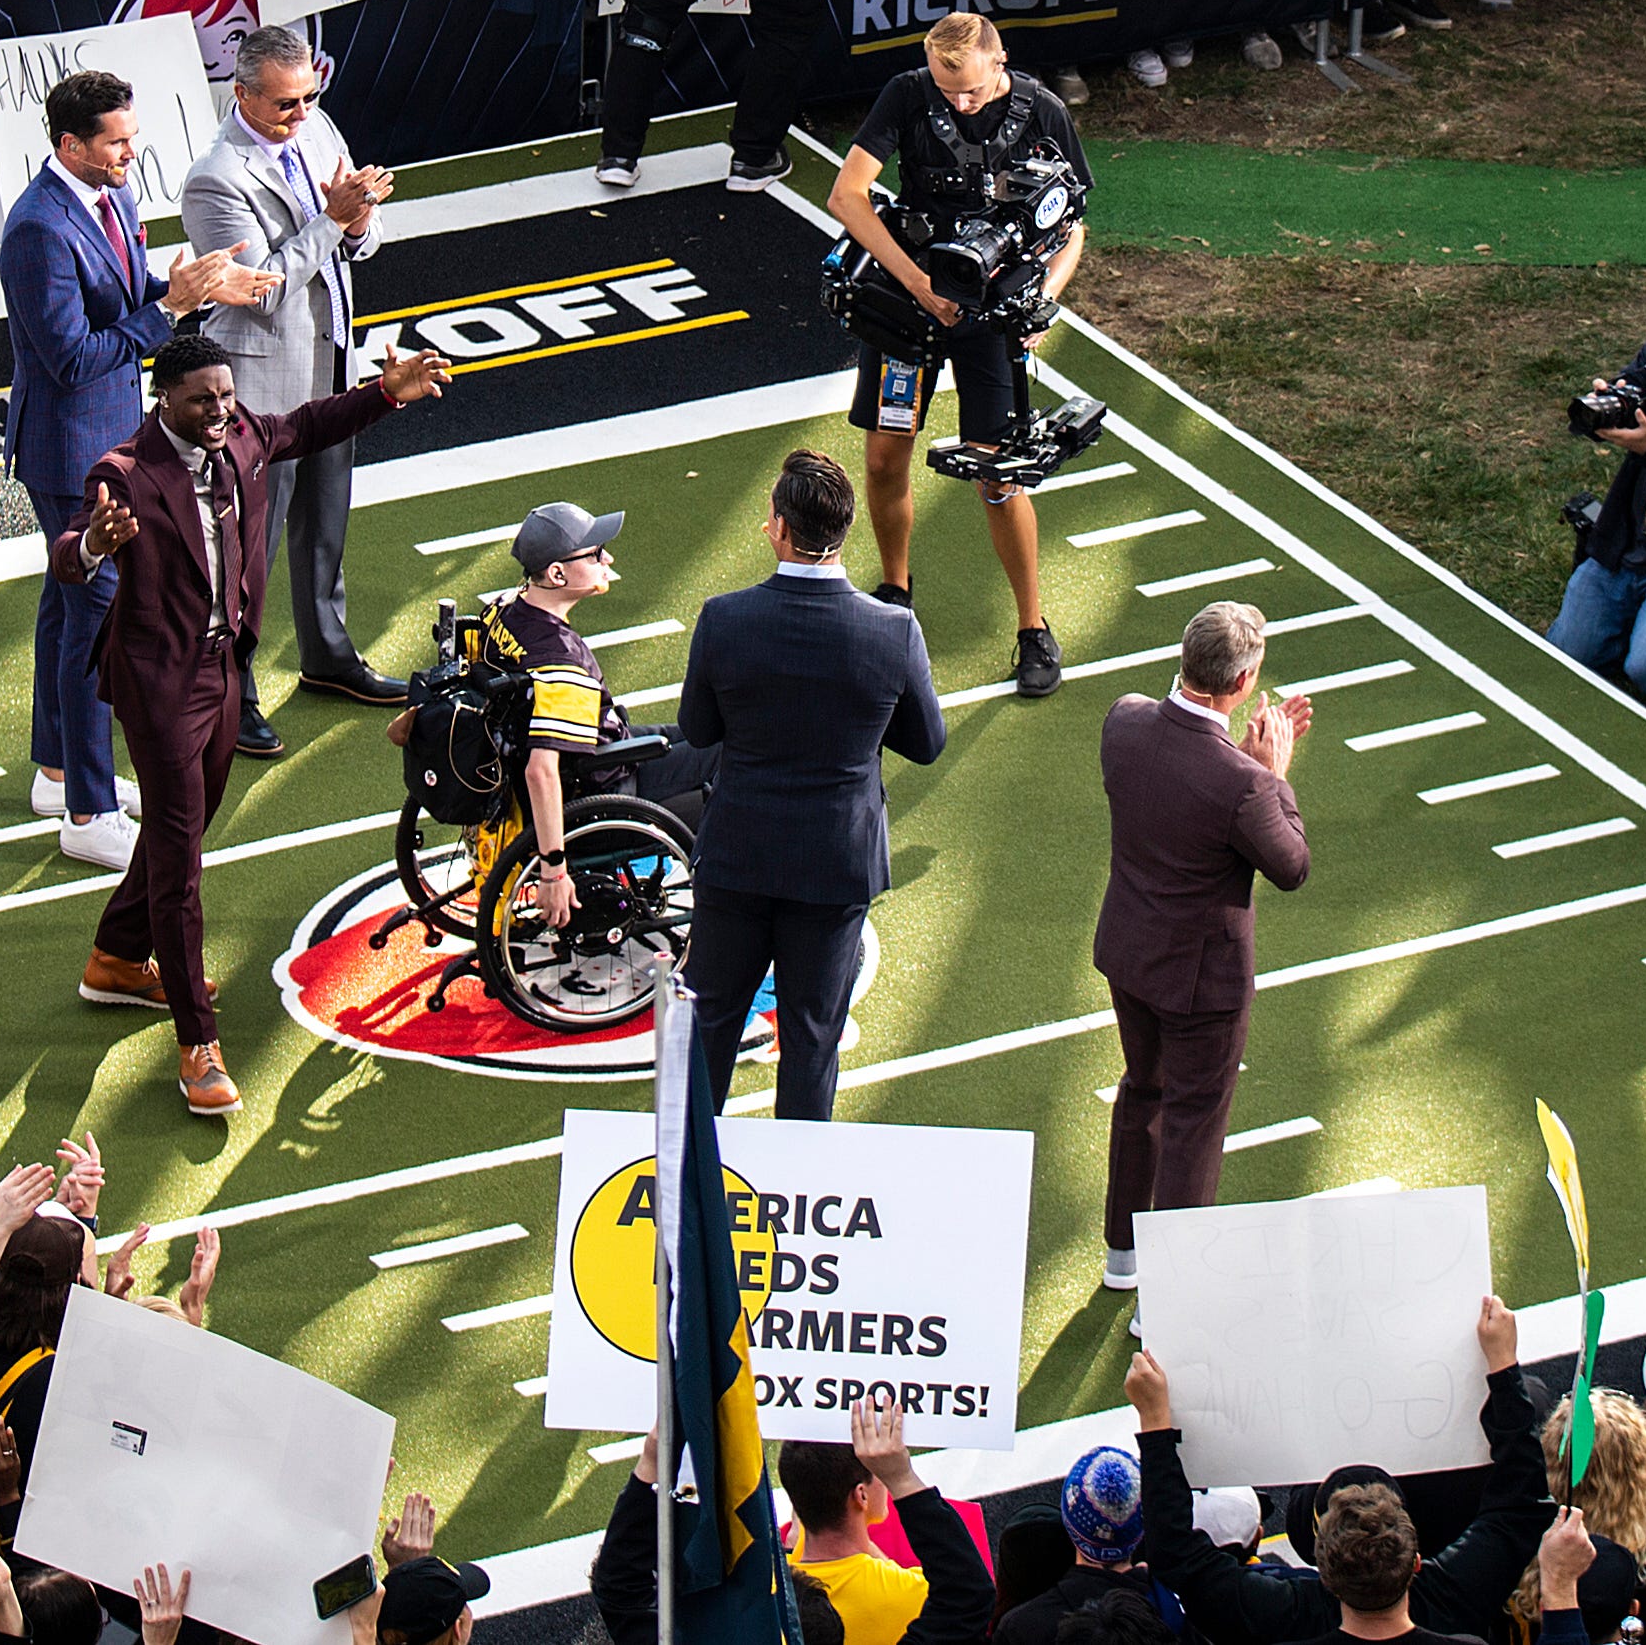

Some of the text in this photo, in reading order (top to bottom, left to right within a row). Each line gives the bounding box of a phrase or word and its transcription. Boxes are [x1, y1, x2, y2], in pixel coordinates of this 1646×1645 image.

[353, 267, 707, 380] KOFF
[616, 1174, 882, 1240] AERICA
[742, 1307, 947, 1358] ARMERS
[751, 1373, 989, 1419] OX SPORTS!
